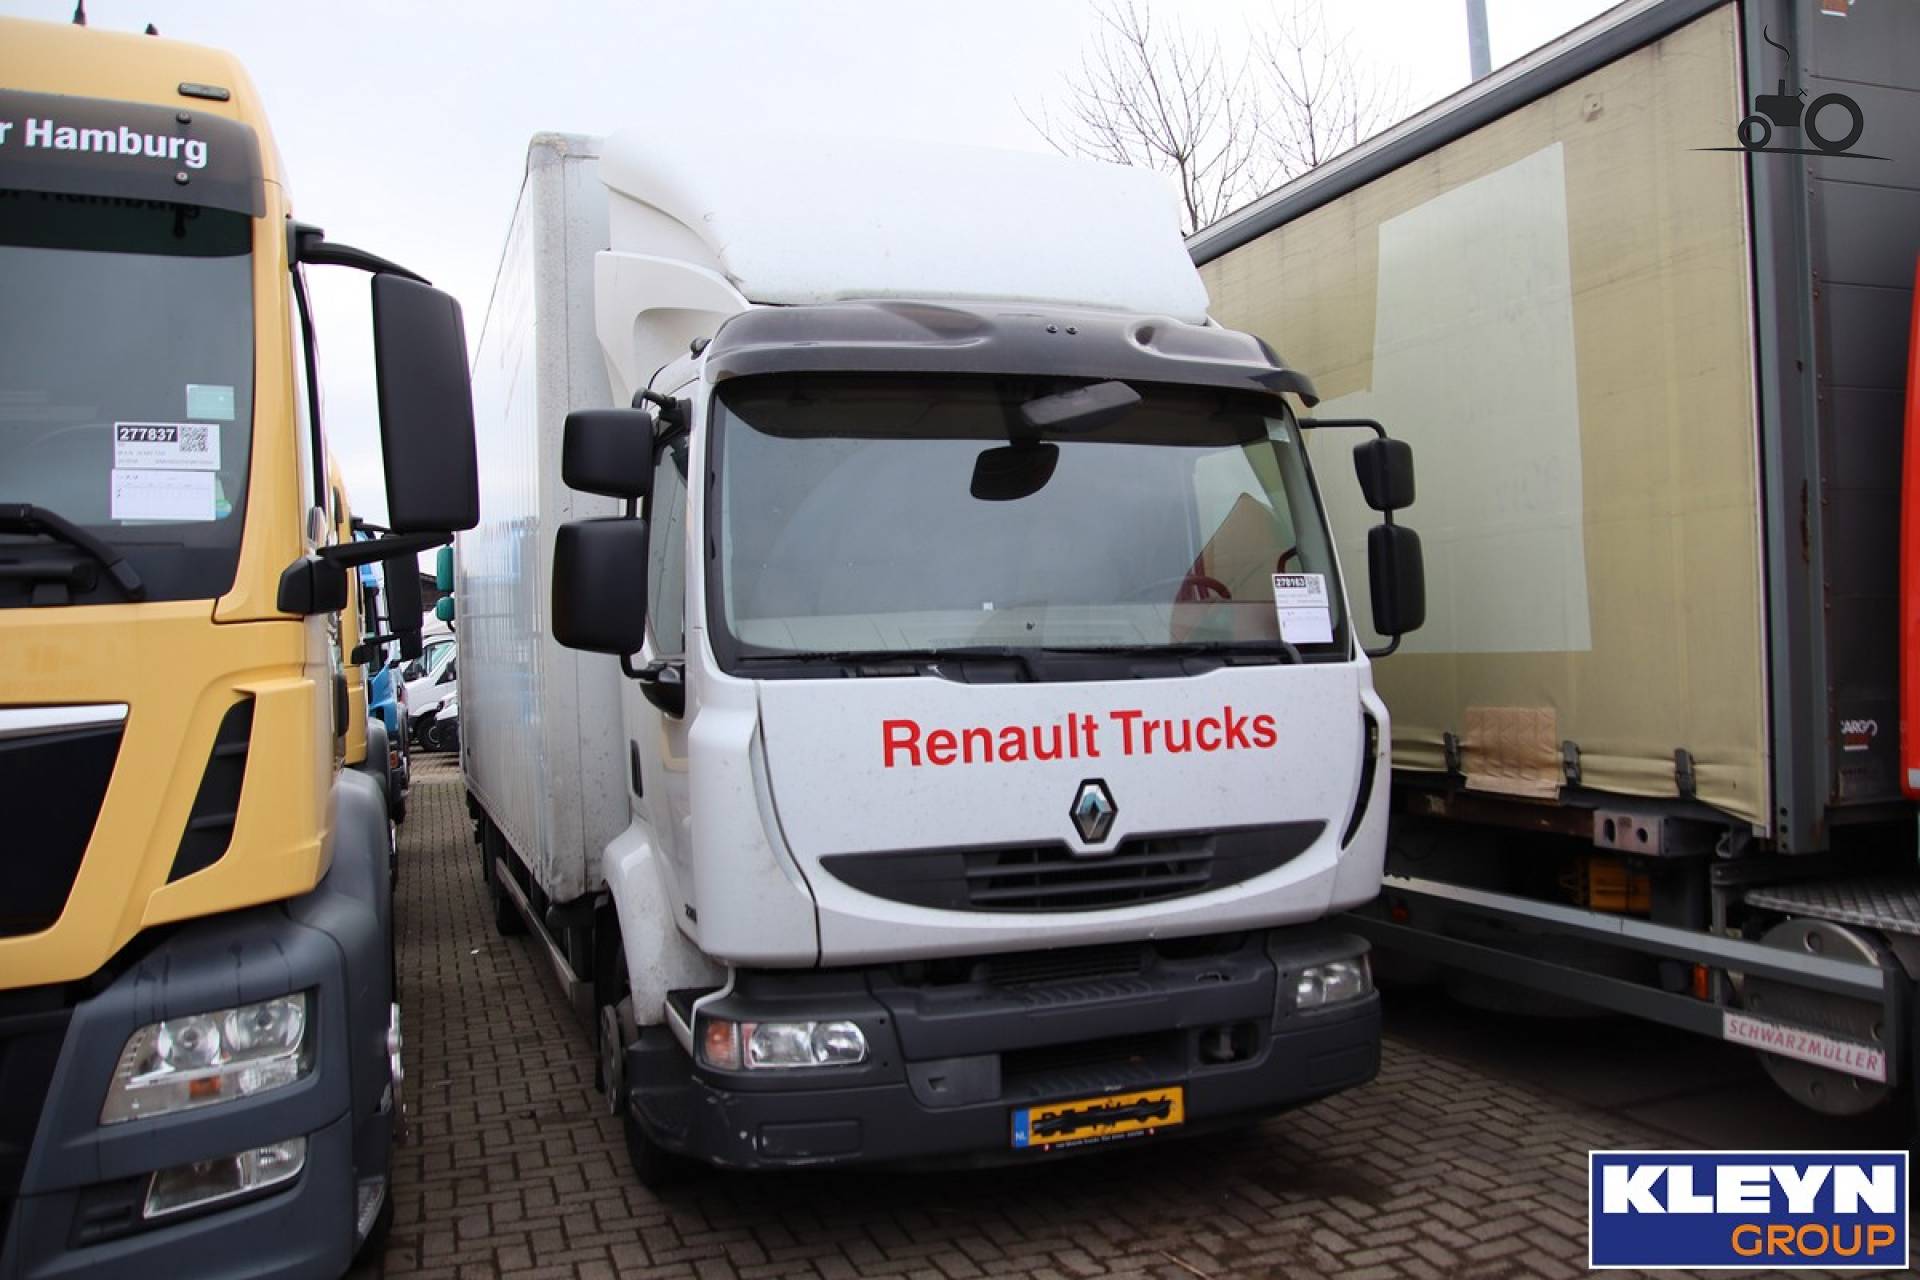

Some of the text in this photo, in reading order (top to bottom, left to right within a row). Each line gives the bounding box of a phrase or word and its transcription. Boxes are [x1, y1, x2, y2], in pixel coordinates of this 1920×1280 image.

[25, 118, 207, 169] Hamburg
[882, 705, 1278, 768] Renault Trucks
